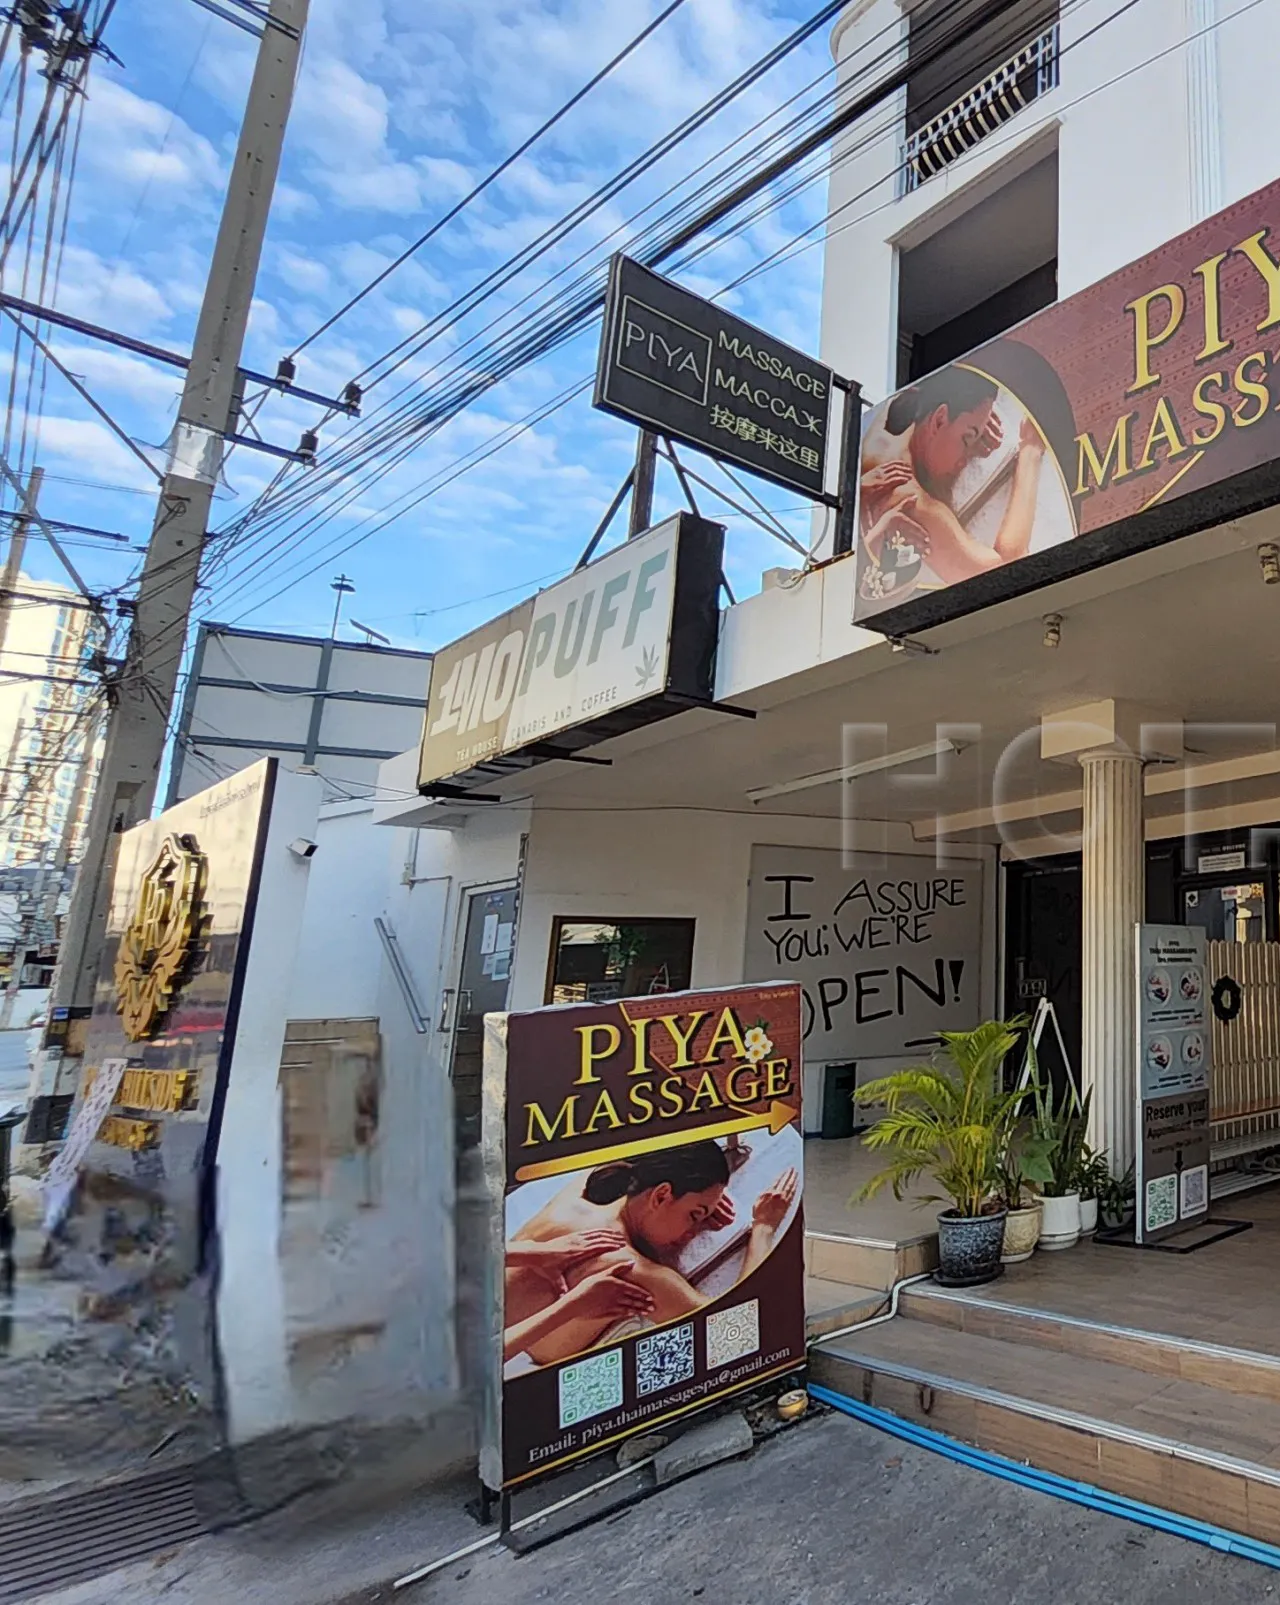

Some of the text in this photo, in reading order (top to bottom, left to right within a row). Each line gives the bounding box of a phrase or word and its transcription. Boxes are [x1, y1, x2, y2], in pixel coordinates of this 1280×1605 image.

[625, 320, 704, 384] PIYA
[718, 330, 826, 399] MASSAGE
[710, 404, 820, 473] 按摩来这里
[553, 705, 572, 723] AND
[580, 685, 617, 713] COFFEE
[764, 875, 966, 921] I ASSURE
[573, 1006, 748, 1086] PIYA
[521, 1058, 793, 1147] MASSAGE
[1146, 1103, 1184, 1122] Reserve
[528, 1346, 791, 1463] Email: piya.thaimassagespa@gmail.com
